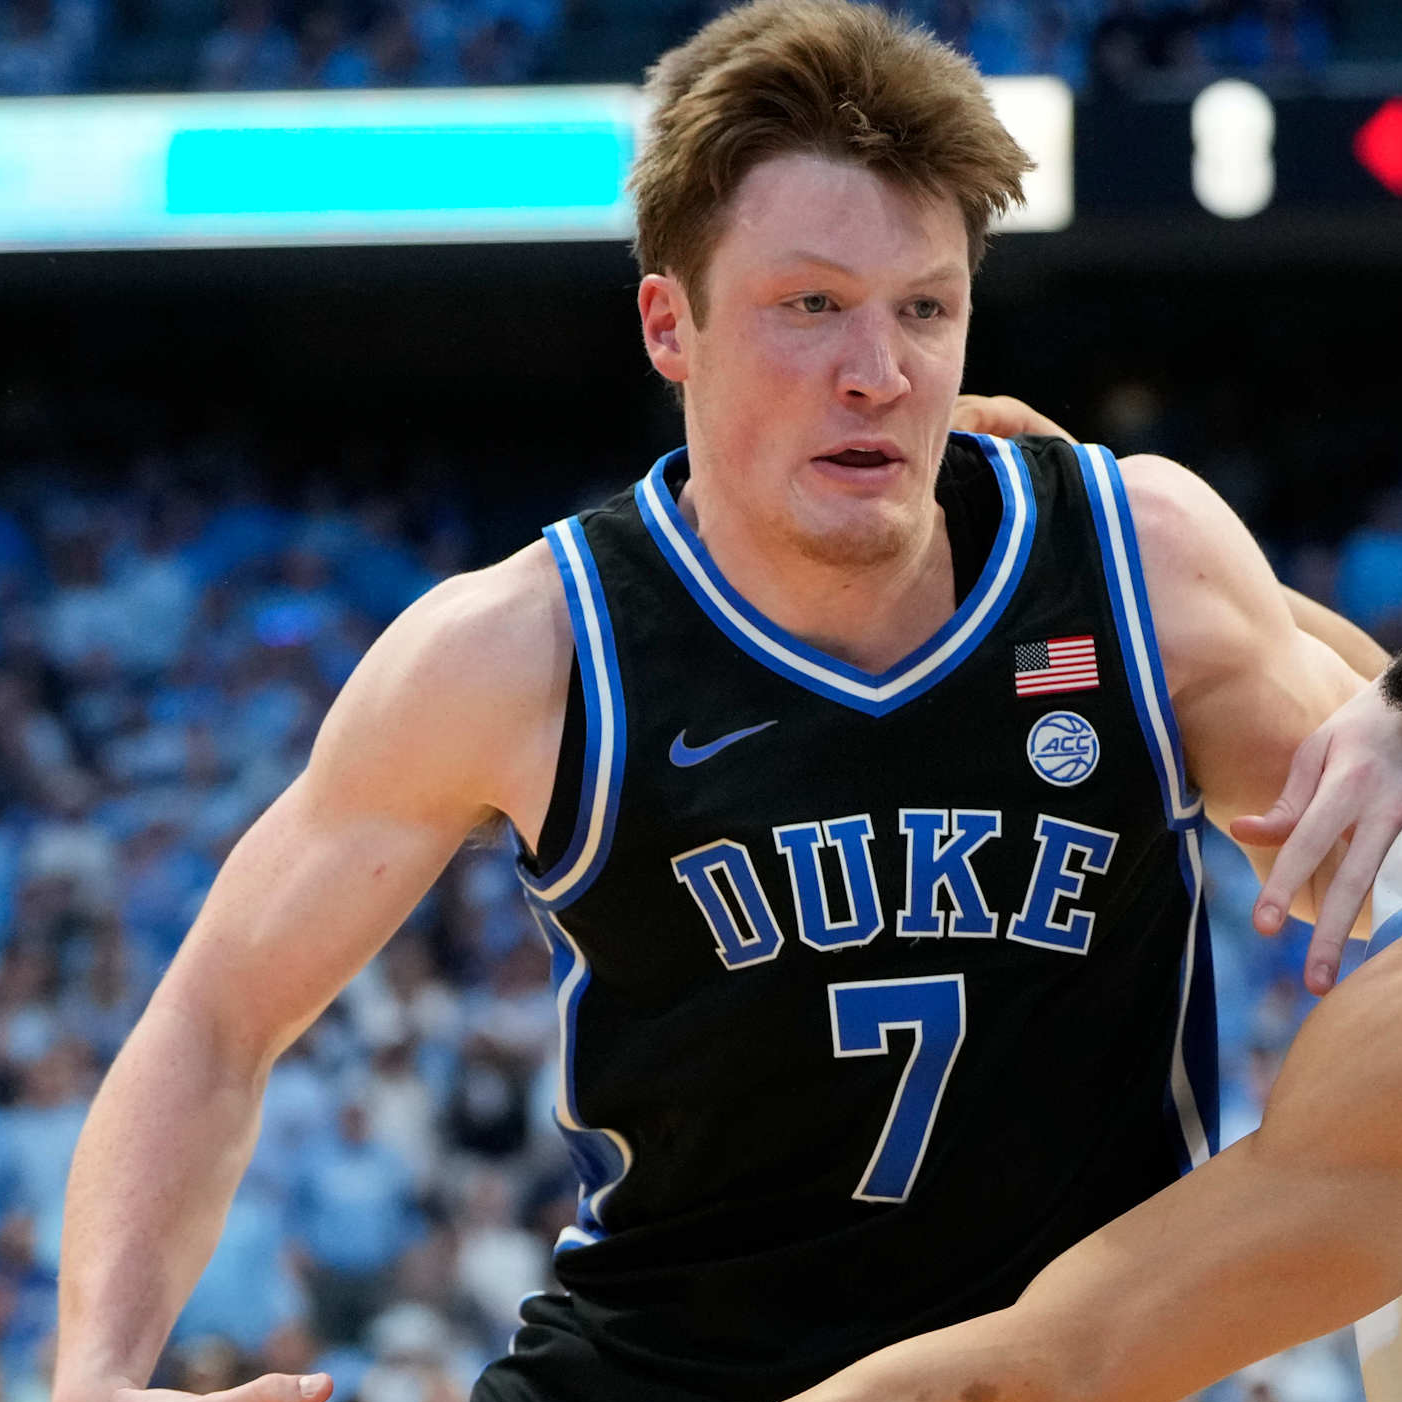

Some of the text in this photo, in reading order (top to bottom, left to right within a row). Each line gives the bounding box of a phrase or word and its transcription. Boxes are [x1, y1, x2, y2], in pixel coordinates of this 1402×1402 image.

[1041, 733, 1093, 752] ACC
[670, 808, 1120, 970] DUKE
[827, 973, 967, 1203] 7
